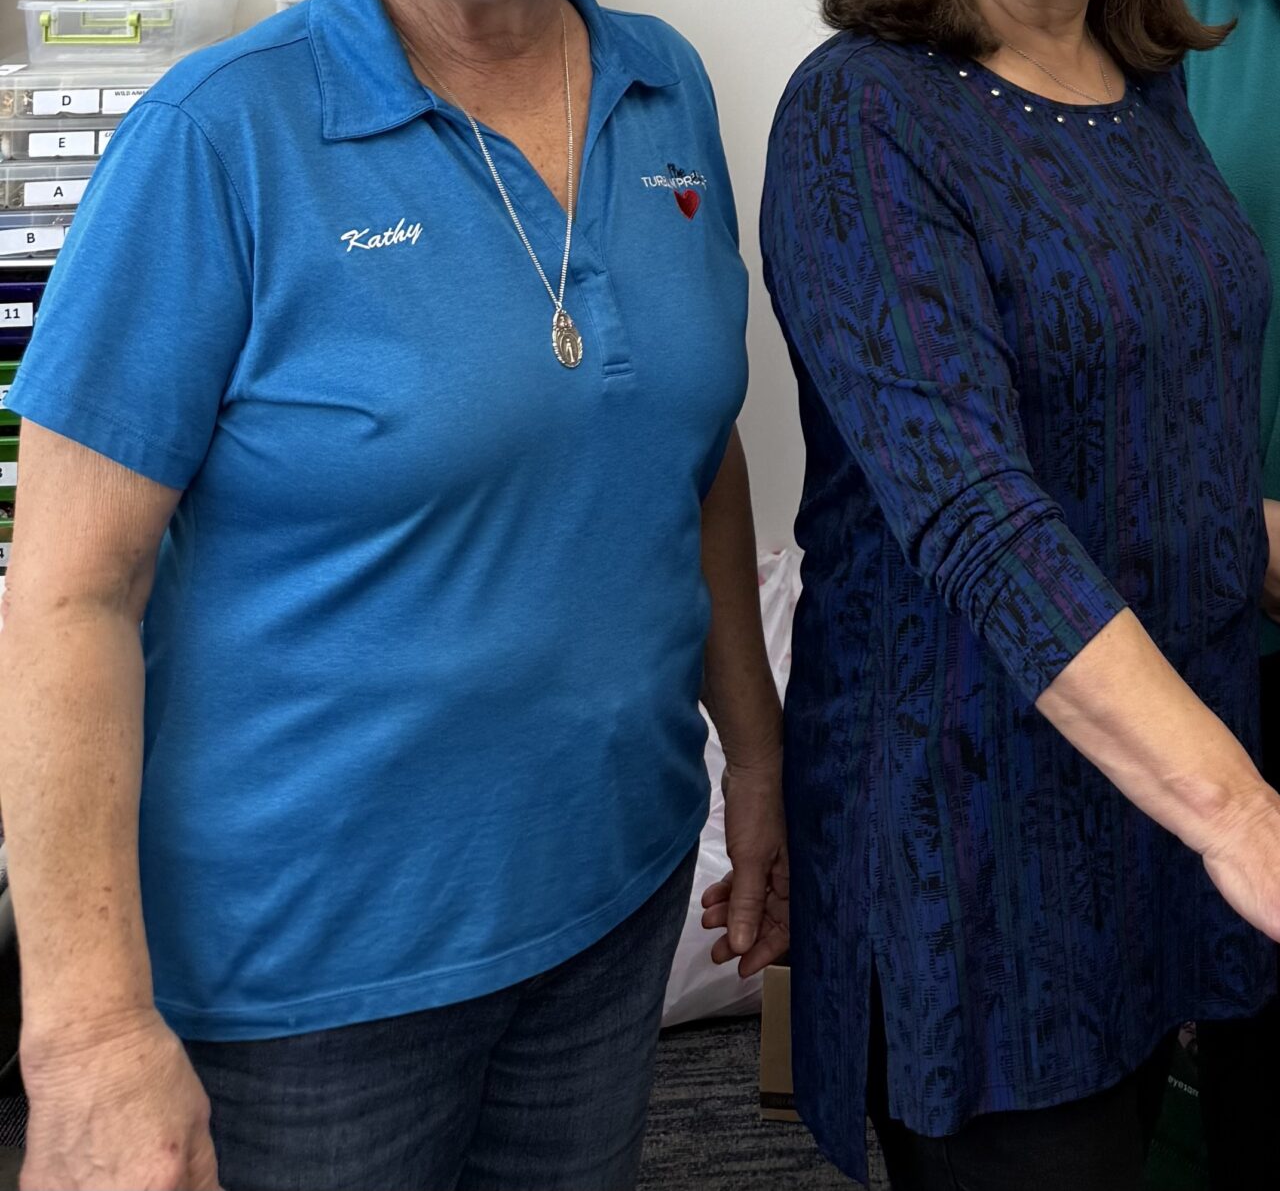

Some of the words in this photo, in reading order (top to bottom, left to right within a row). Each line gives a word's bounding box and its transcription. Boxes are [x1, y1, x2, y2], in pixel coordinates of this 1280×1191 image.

[62, 95, 71, 106] D
[59, 138, 66, 148] E
[53, 187, 64, 198] A
[27, 232, 36, 243] B
[341, 218, 423, 252] Kathy
[4, 308, 20, 319] 11
